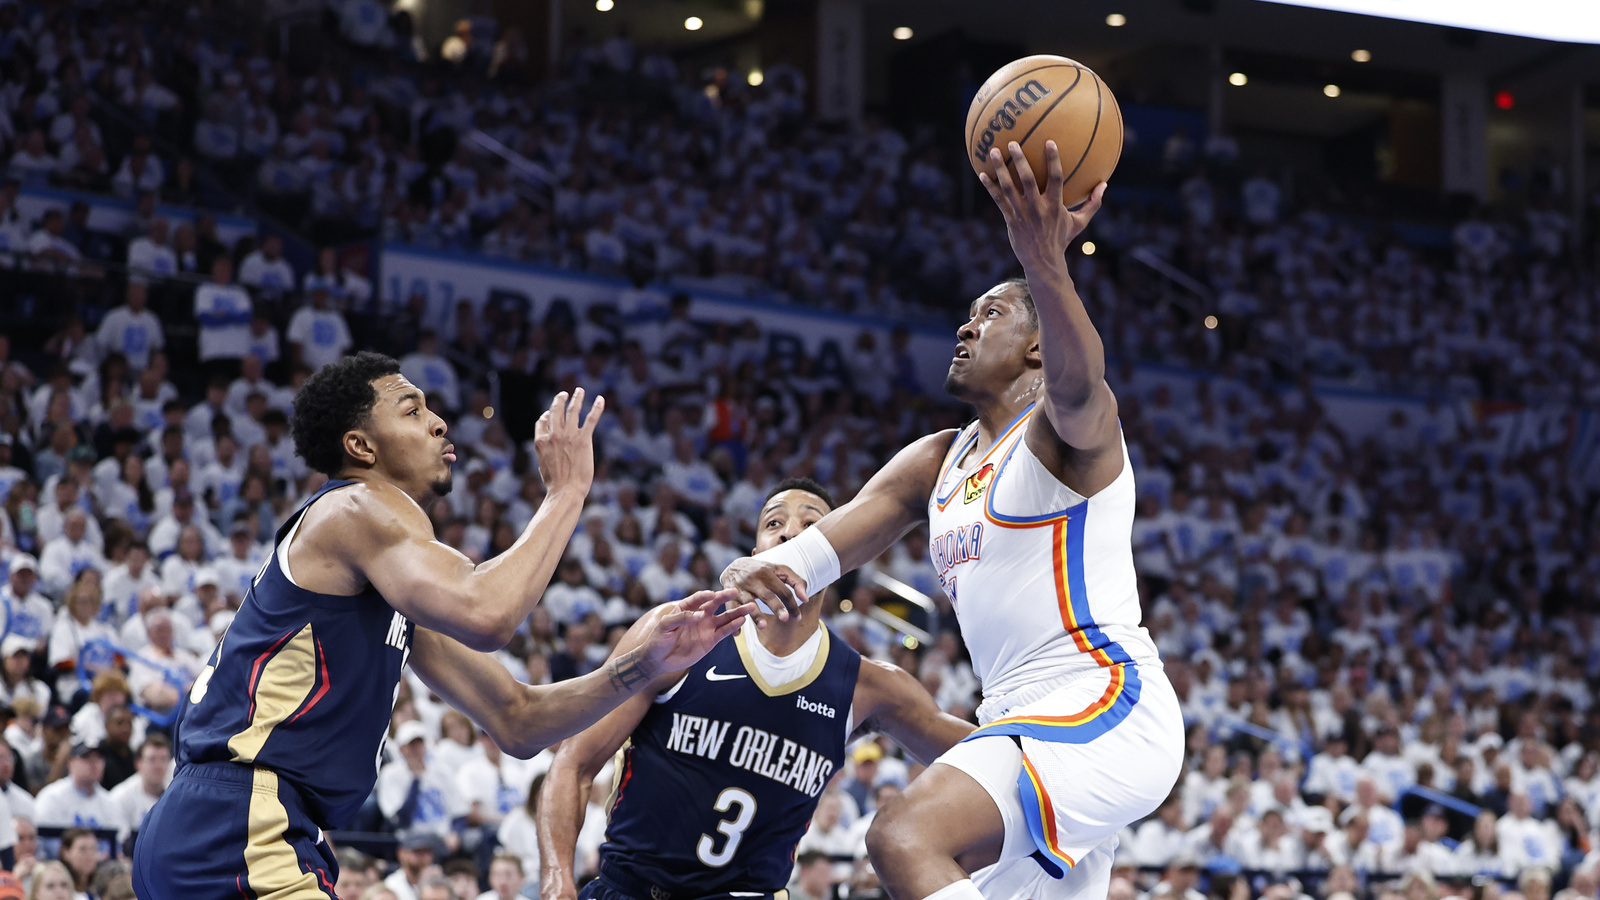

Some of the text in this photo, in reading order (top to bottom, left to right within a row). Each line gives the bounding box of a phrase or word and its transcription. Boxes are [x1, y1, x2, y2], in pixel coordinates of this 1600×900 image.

[975, 79, 1053, 163] Wilson
[931, 522, 983, 574] HOMA
[385, 610, 408, 651] NE
[796, 695, 836, 719] ibotta
[666, 712, 834, 798] NEW ORLEANS
[696, 787, 758, 868] 3
